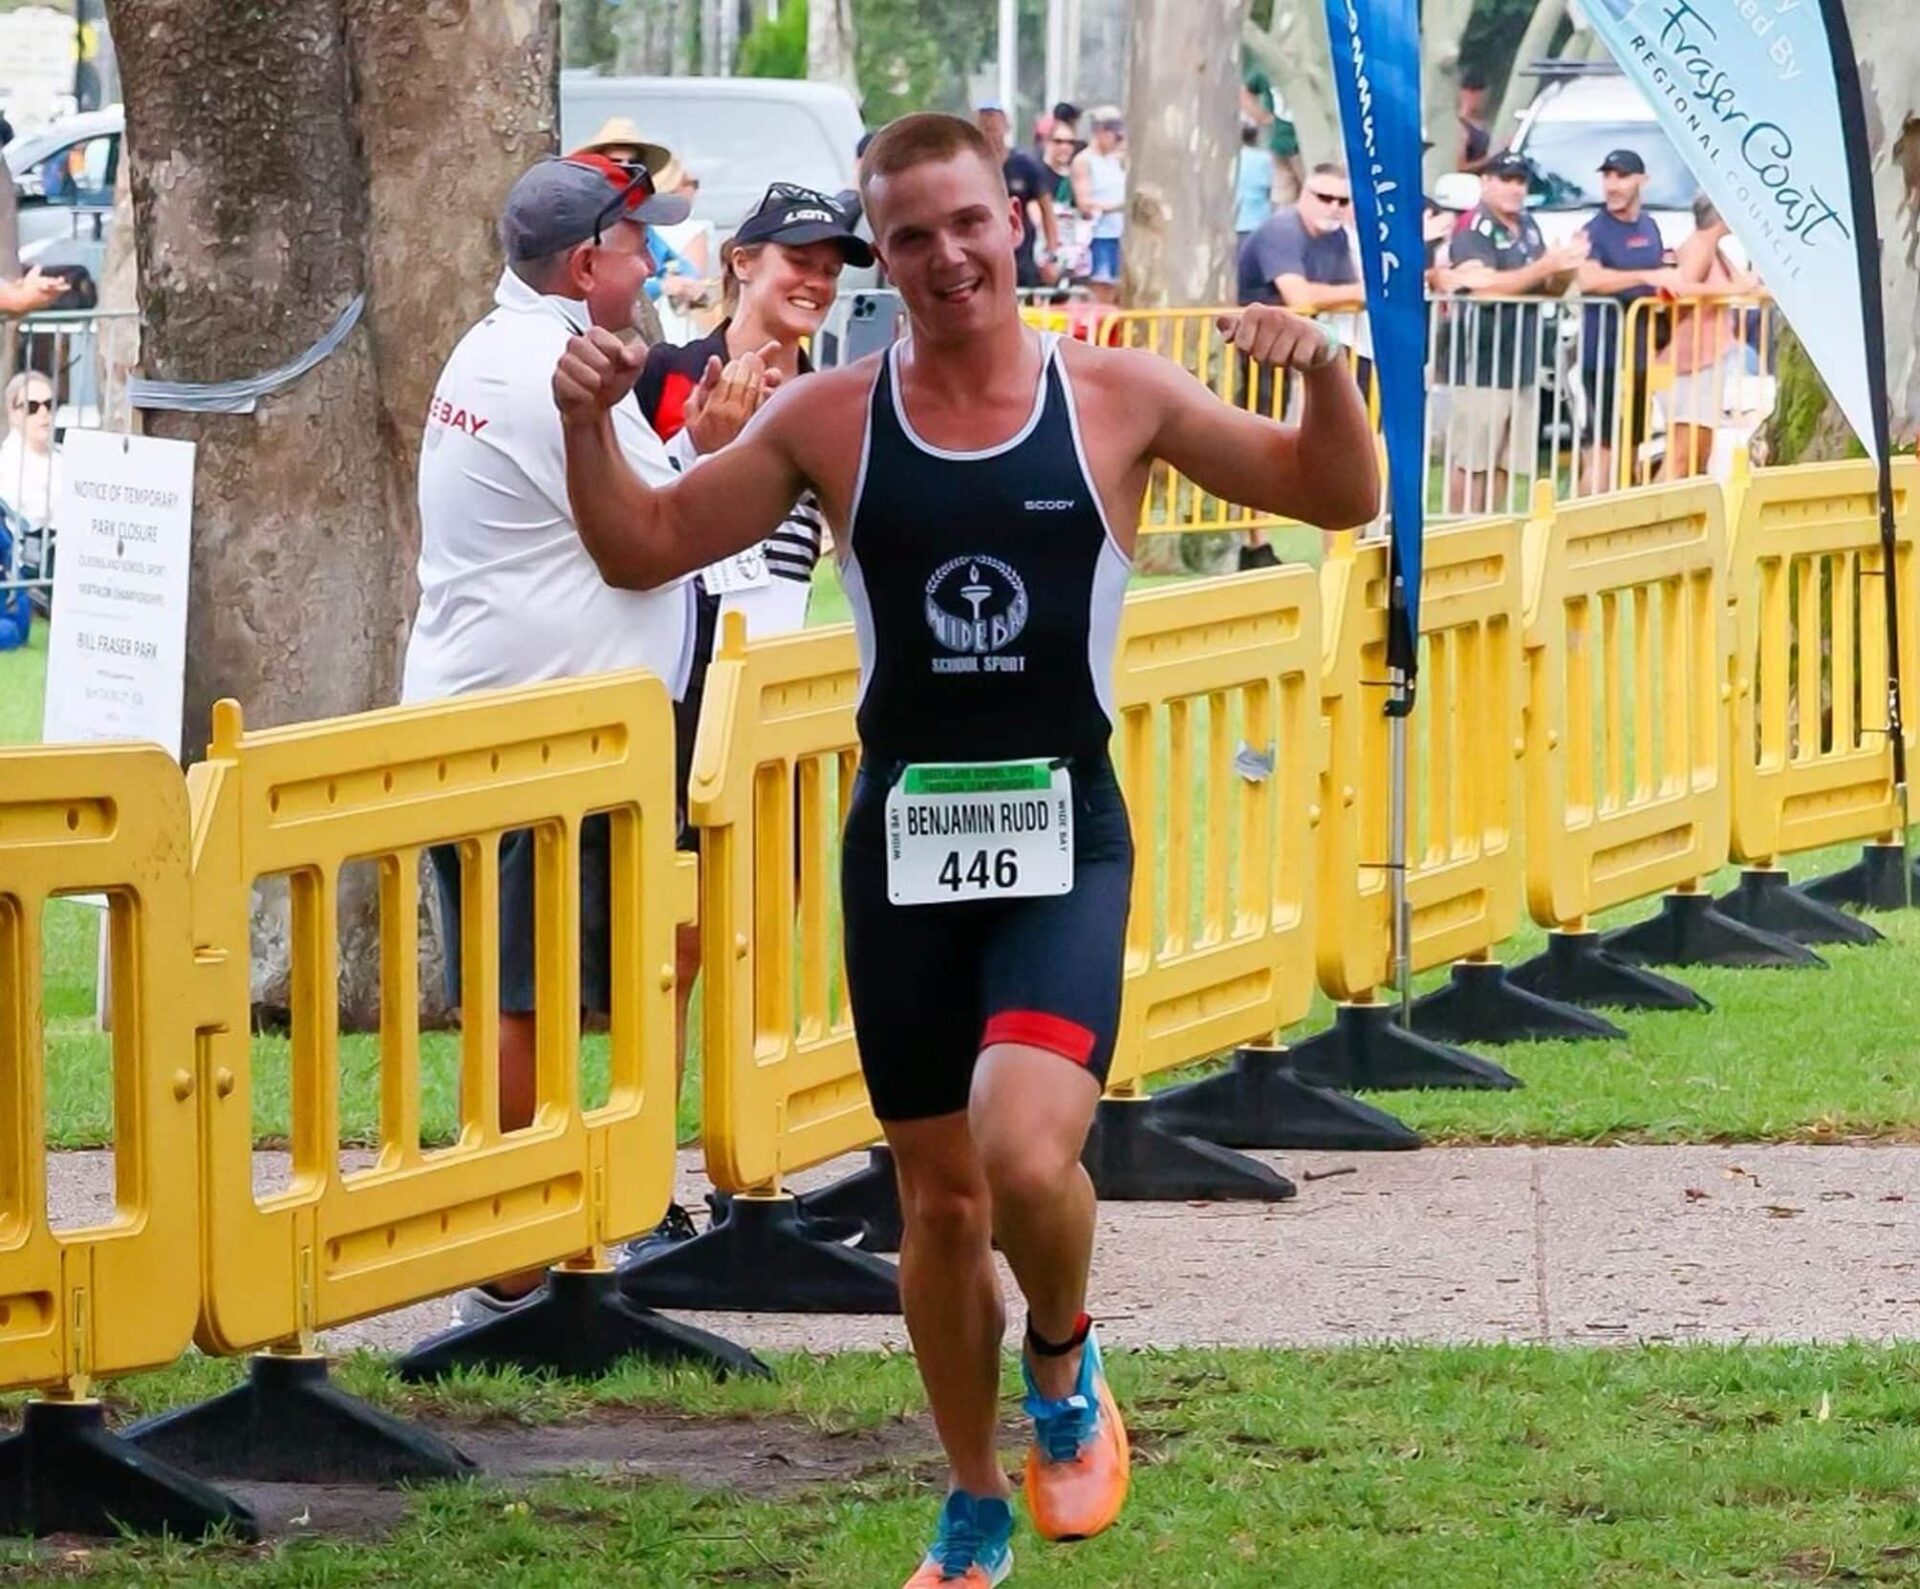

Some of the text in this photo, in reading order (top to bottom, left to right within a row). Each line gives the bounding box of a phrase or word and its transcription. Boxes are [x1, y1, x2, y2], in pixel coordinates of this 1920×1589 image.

[1768, 34, 1804, 80] By
[1660, 0, 1850, 246] Fraser Coast
[1630, 34, 1801, 279] REGIONAL COUNCIL
[1024, 500, 1075, 511] SCODY
[891, 808, 902, 861] WIDE BAY
[907, 800, 1049, 836] BENJAMIN RUDD
[1058, 800, 1068, 852] WIDE BAY
[938, 848, 1019, 892] 446
